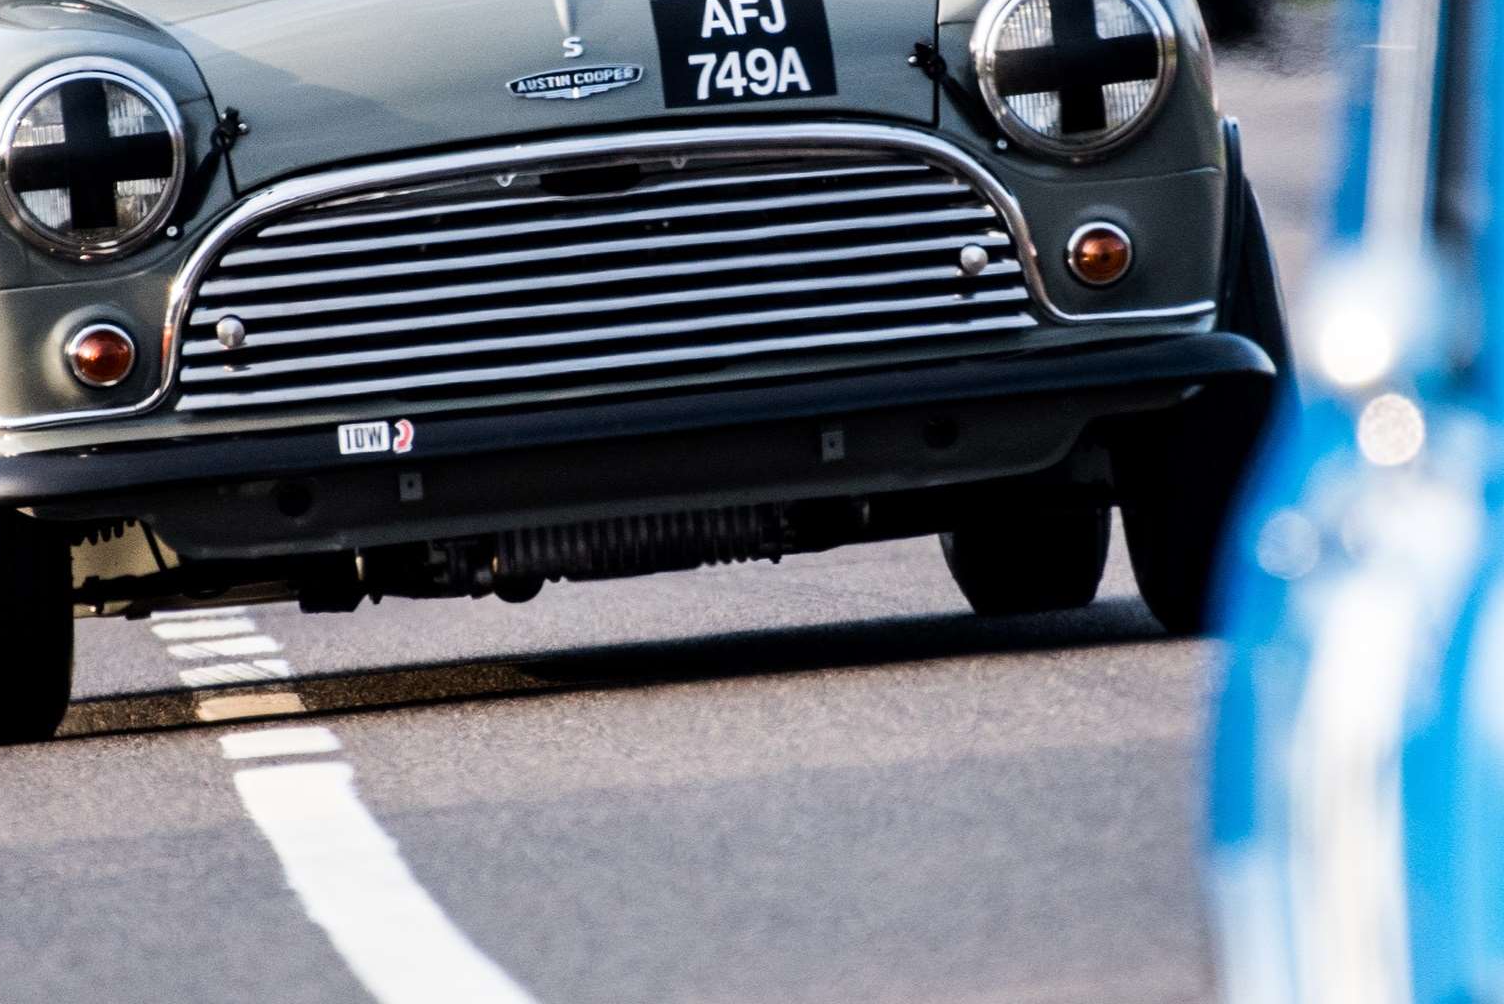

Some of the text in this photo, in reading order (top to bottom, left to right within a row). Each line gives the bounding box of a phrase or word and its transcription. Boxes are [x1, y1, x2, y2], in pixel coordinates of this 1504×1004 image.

[562, 36, 583, 58] S
[516, 66, 634, 93] AUSTIN COOPER
[688, 47, 811, 100] 749A
